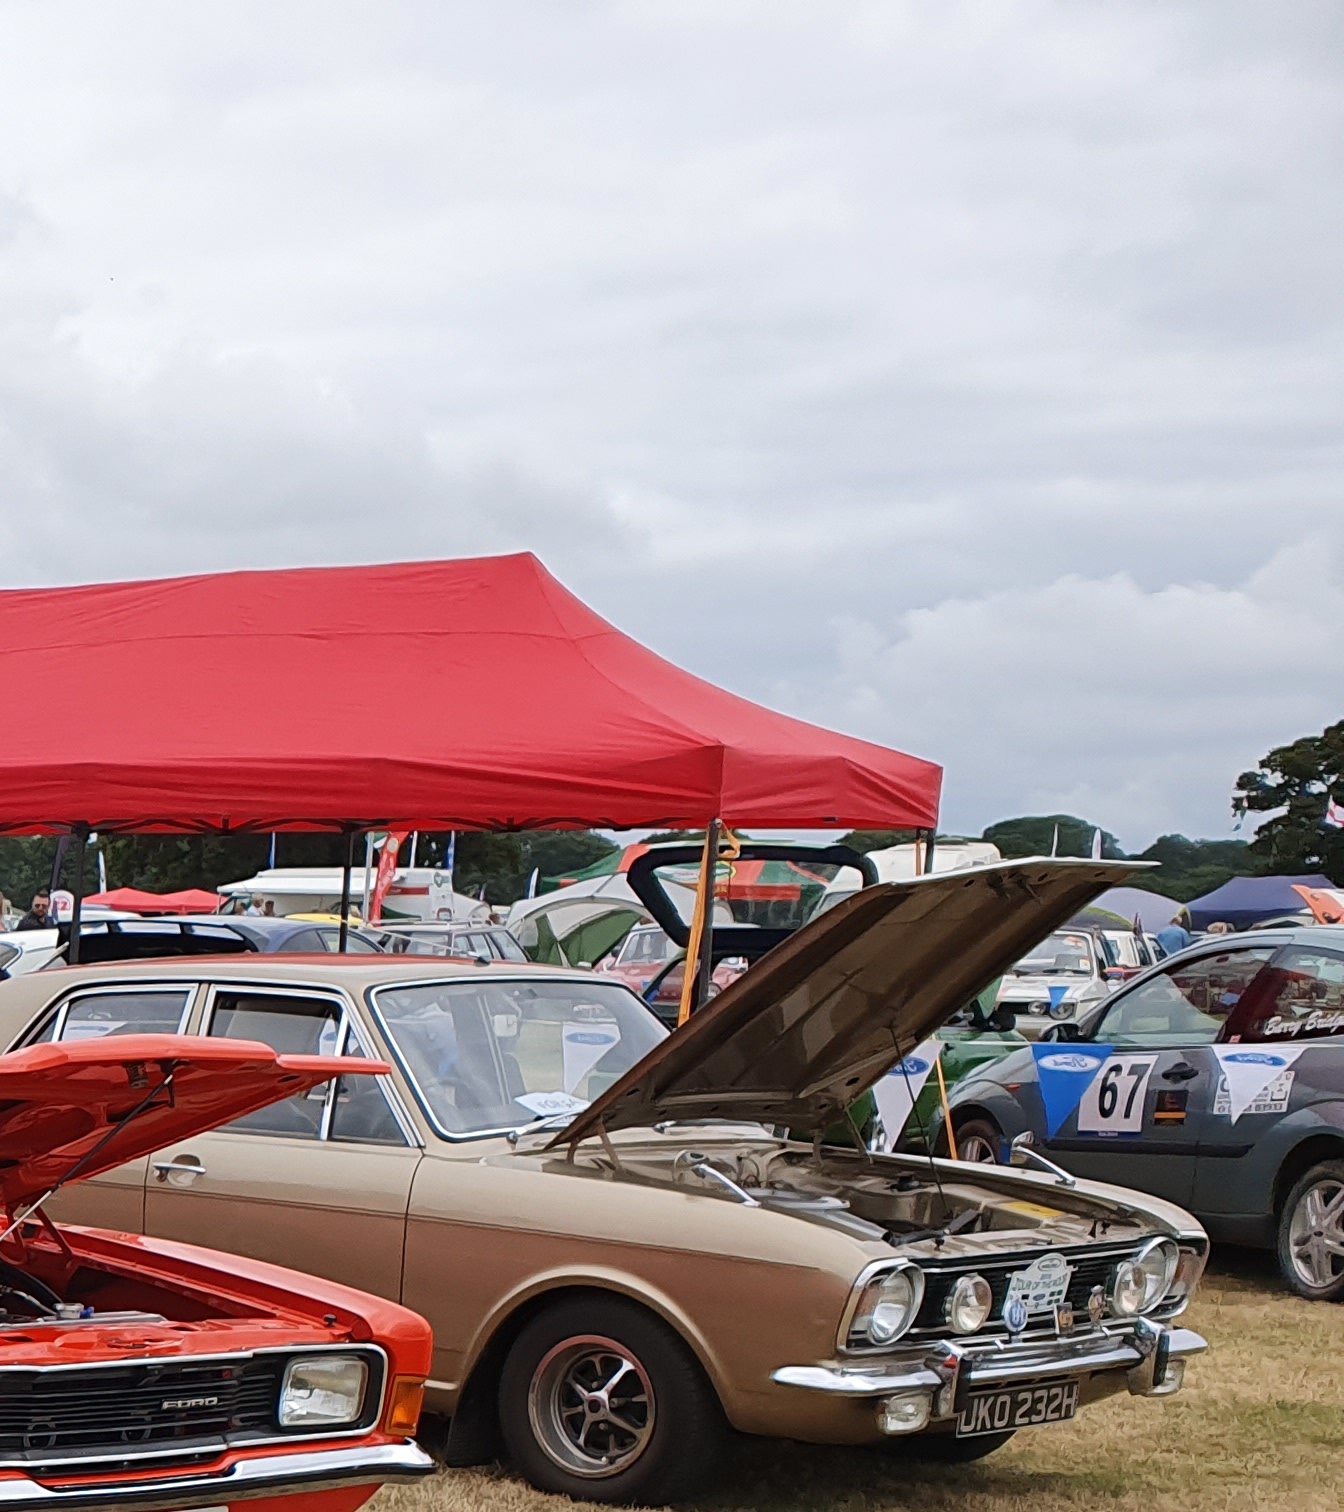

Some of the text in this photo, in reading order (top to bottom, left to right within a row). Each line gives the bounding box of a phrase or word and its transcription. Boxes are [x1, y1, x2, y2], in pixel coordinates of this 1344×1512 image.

[1098, 1063, 1146, 1120] 67
[162, 1397, 218, 1410] FORD
[960, 1385, 1077, 1432] JKO 232H
